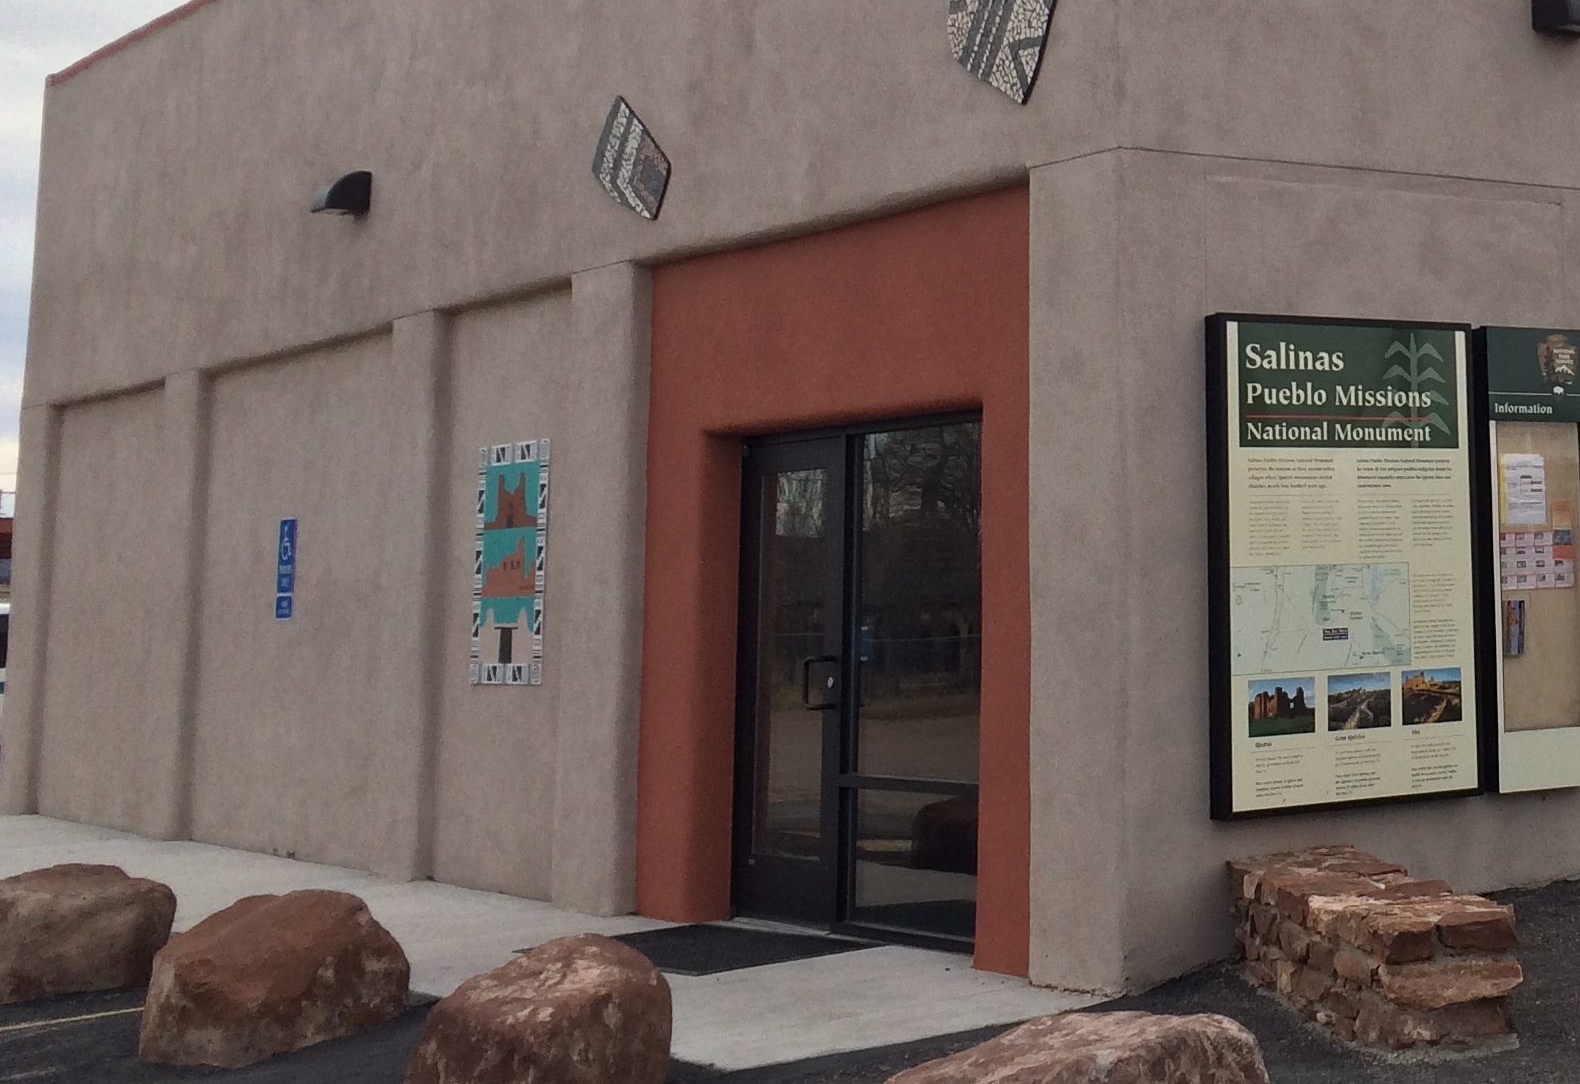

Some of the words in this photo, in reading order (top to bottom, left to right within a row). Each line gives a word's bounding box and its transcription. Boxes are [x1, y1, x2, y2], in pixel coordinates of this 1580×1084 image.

[1245, 341, 1345, 372] Salinas
[1246, 381, 1327, 406] Pueblo
[1335, 384, 1432, 408] Missions
[1494, 402, 1553, 414] Information
[1247, 421, 1328, 441] National
[1334, 423, 1432, 442] Monument
